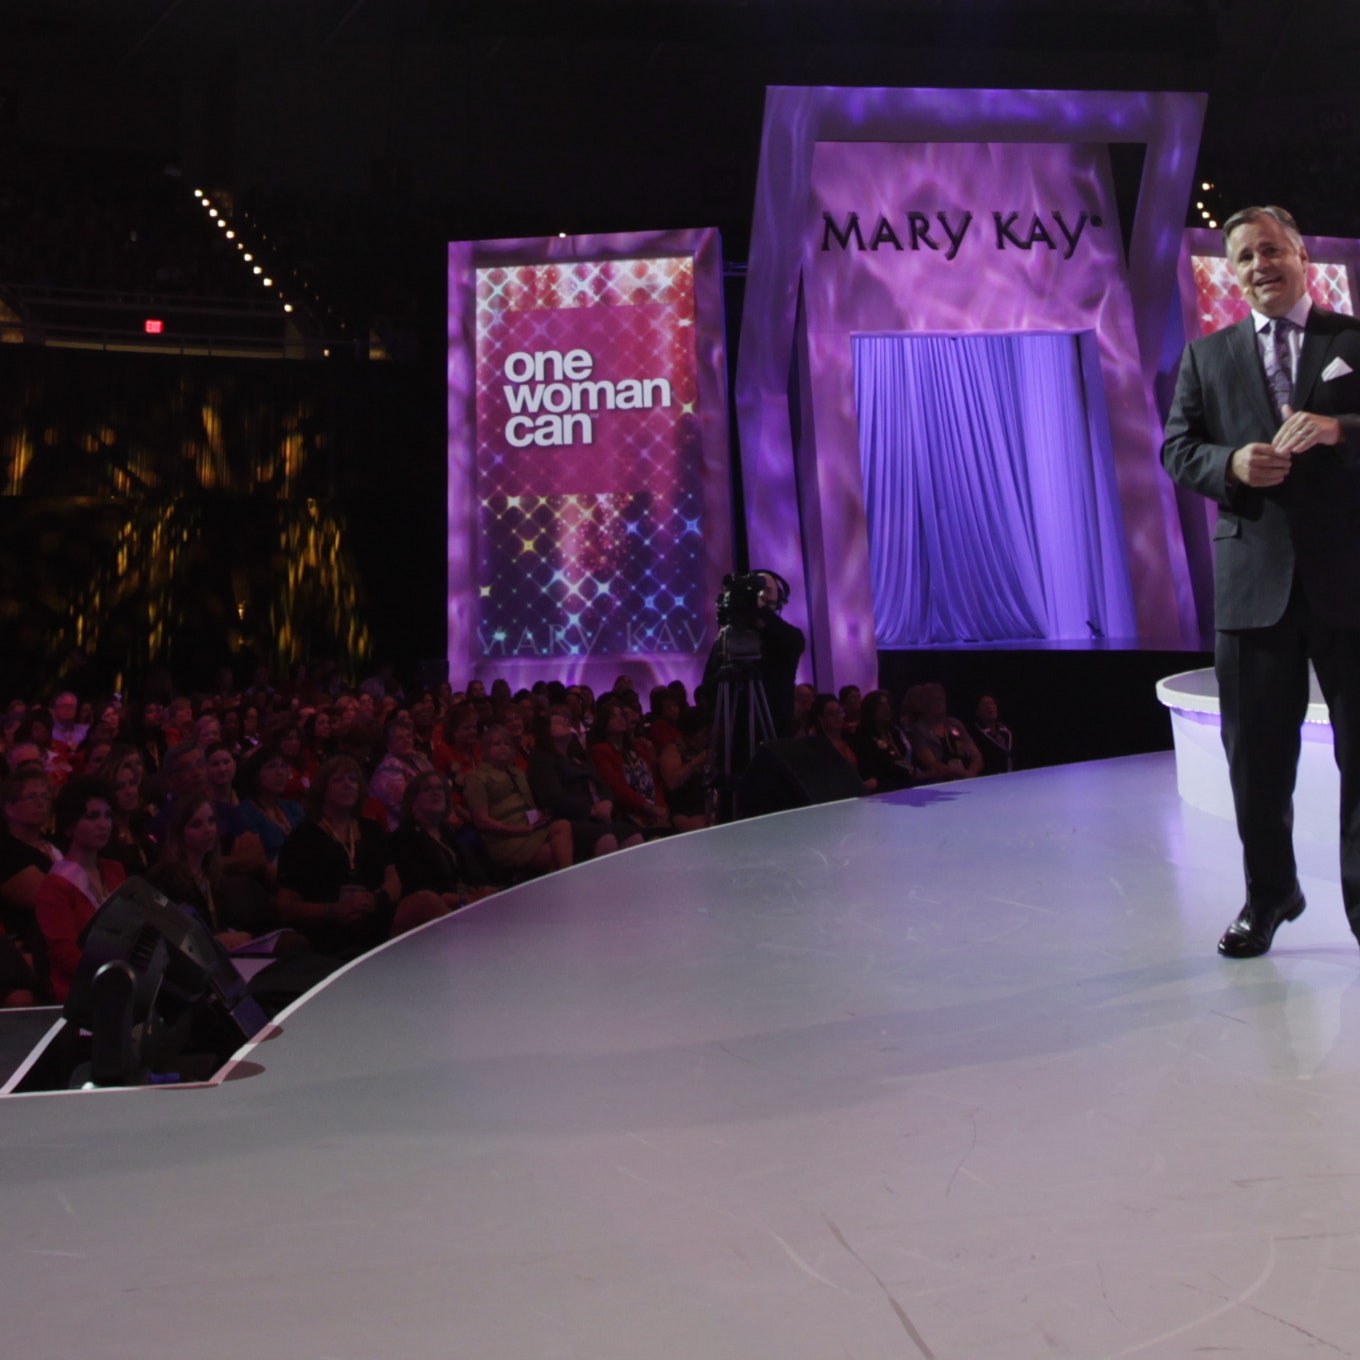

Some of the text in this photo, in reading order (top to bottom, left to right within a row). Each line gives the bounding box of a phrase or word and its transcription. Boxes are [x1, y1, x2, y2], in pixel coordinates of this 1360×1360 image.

[820, 211, 973, 261] MARY
[503, 348, 593, 383] one
[502, 377, 672, 414] woman
[504, 412, 593, 448] can
